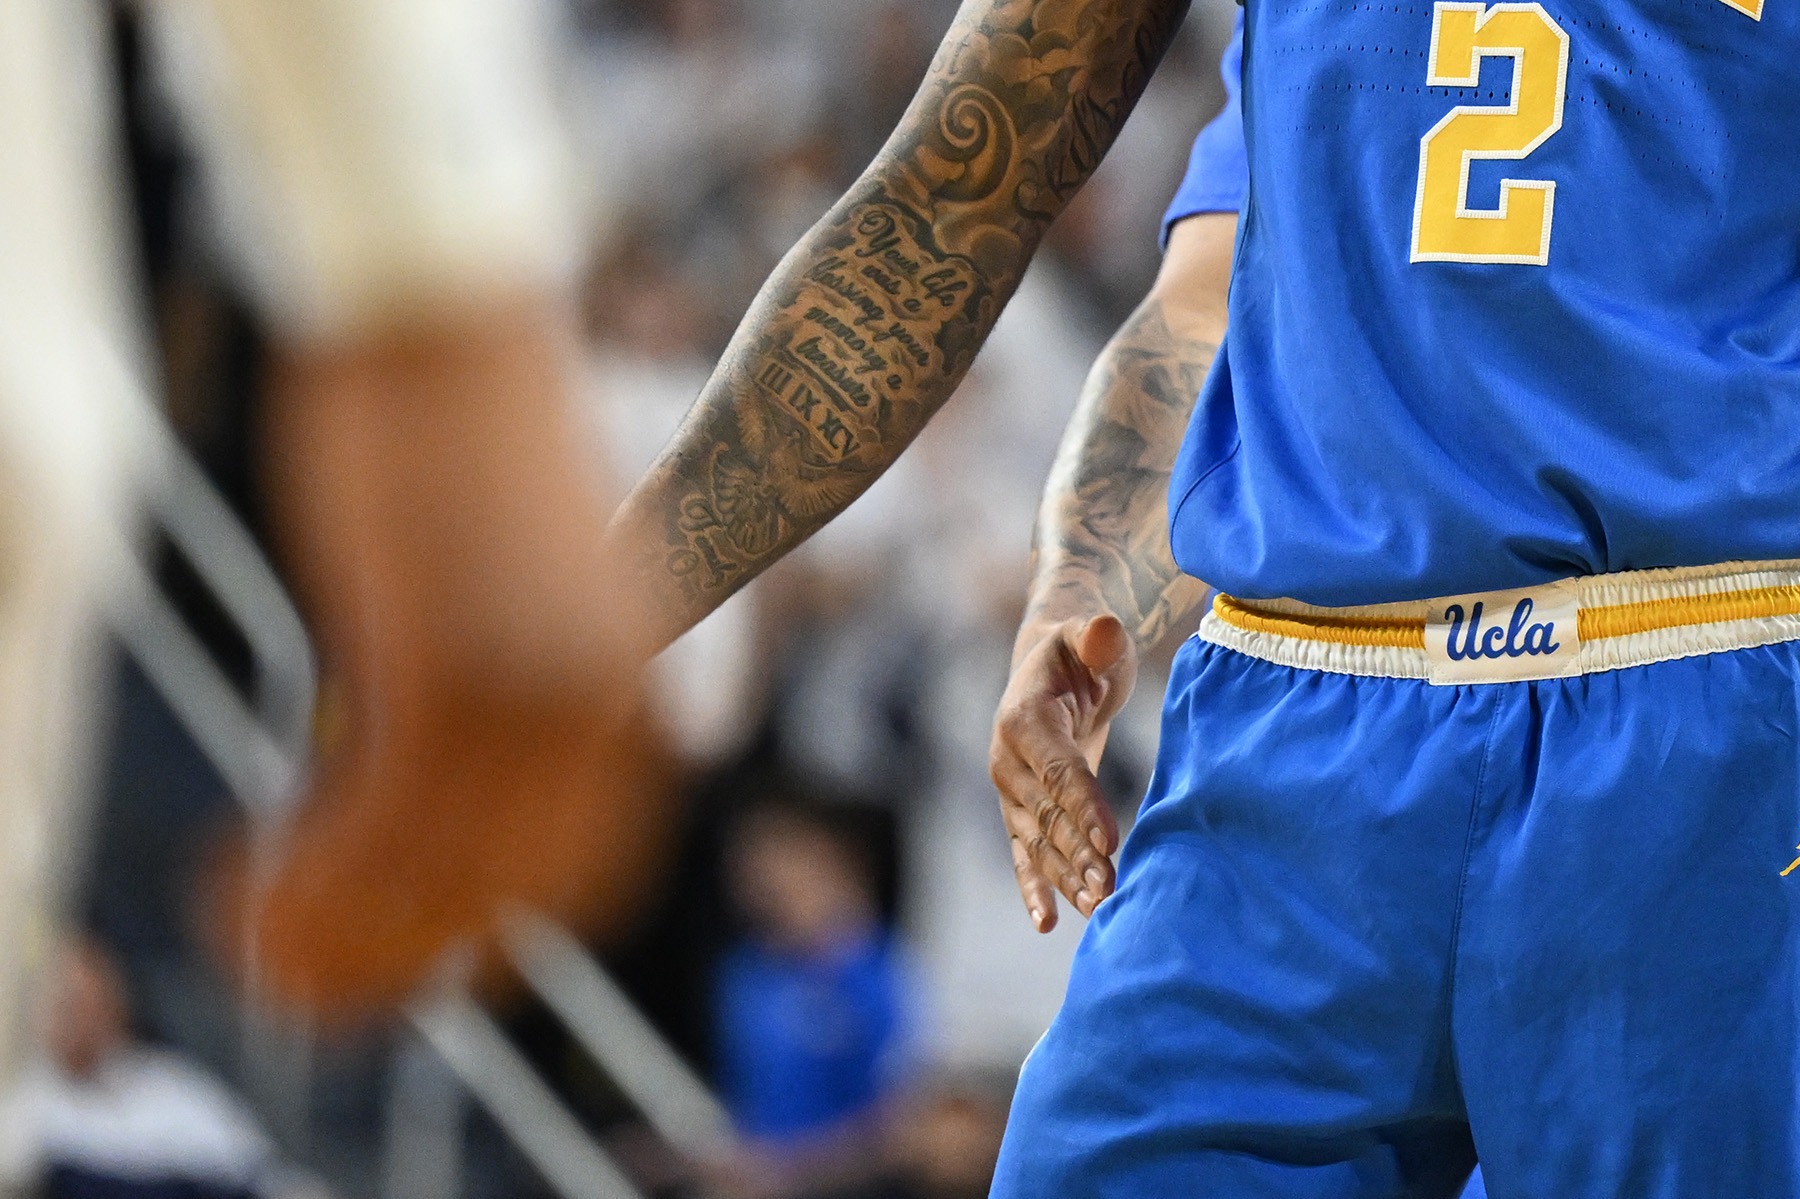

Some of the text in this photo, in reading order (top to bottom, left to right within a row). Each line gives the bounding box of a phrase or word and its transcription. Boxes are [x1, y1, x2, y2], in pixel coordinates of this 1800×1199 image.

[1411, 2, 1570, 265] 2
[855, 210, 968, 307] Your life
[861, 265, 921, 312] was a
[797, 336, 871, 407] treasure
[803, 307, 902, 390] memory a
[873, 321, 929, 367] your
[758, 362, 793, 395] III
[788, 383, 822, 422] IX
[1444, 598, 1560, 661] Ucla
